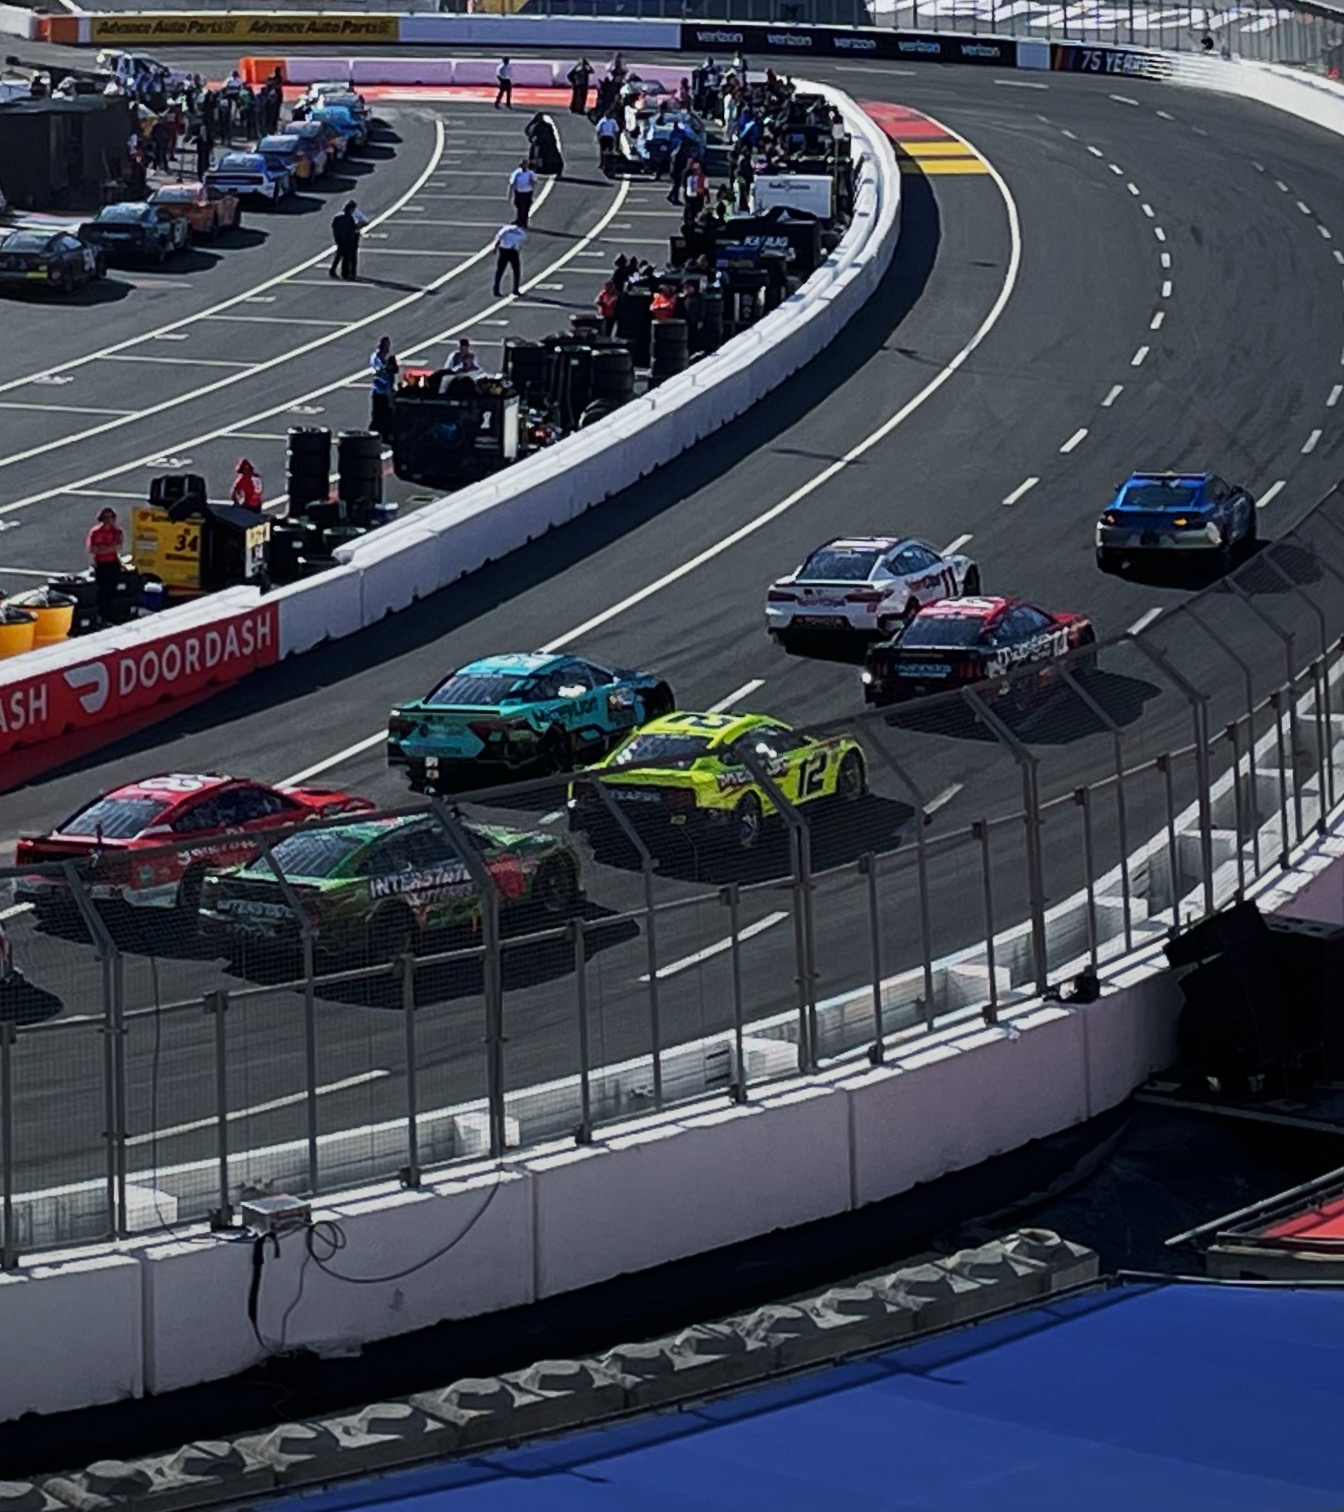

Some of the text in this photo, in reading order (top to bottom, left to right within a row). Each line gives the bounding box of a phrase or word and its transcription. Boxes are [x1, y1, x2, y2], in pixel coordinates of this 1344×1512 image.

[97, 20, 224, 35] Advance Auto Parts
[247, 20, 378, 35] Advance Auto Parts
[695, 29, 745, 45] verizon
[765, 33, 813, 48] verizon
[832, 36, 877, 49] verizon
[896, 39, 942, 55] verizon
[959, 44, 1002, 59] verizon
[1080, 49, 1102, 71] 75
[173, 535, 199, 552] 34
[117, 609, 274, 700] DOORDASH
[797, 743, 828, 792] 12
